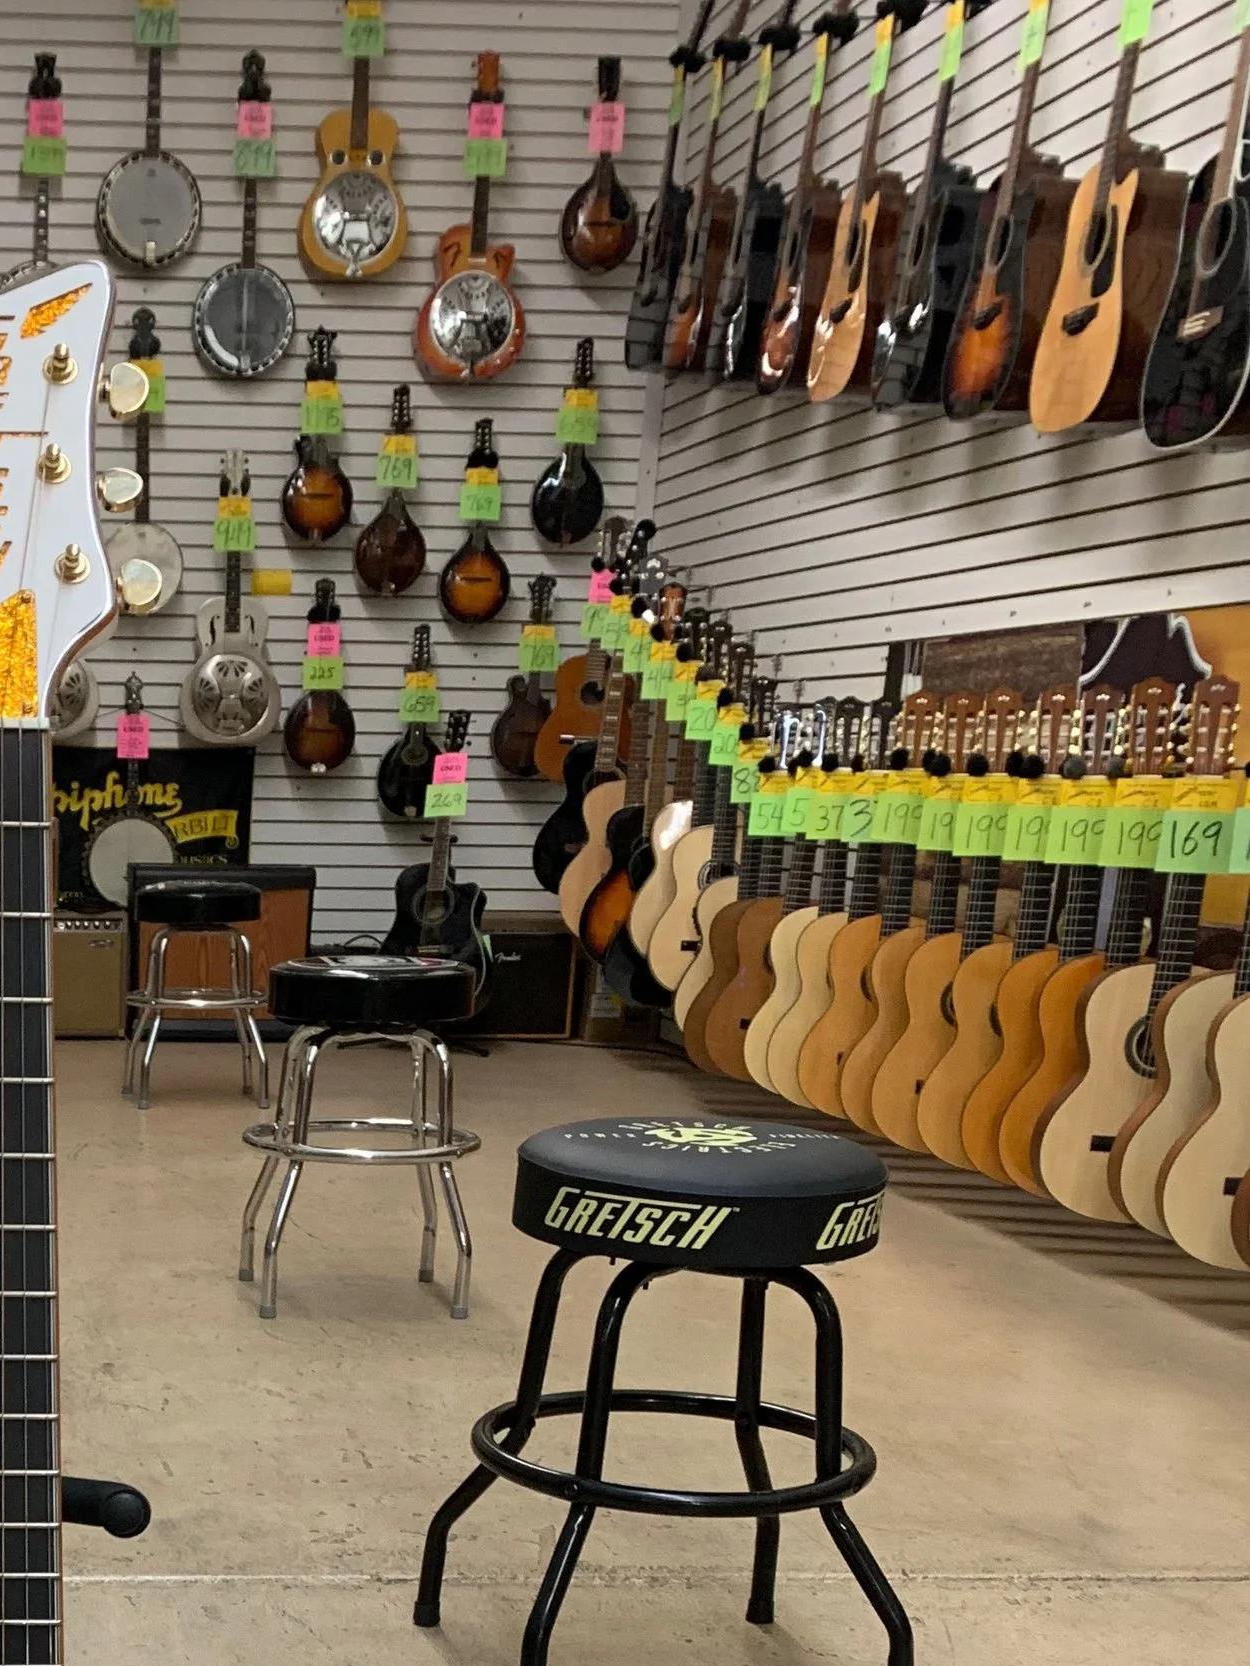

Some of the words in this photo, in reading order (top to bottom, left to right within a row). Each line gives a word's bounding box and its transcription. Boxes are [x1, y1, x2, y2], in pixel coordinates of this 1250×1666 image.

[379, 457, 413, 480] 769
[308, 667, 337, 680] 225
[403, 695, 437, 714] 659
[1170, 820, 1223, 859] 169
[544, 1186, 731, 1250] GRETSCH
